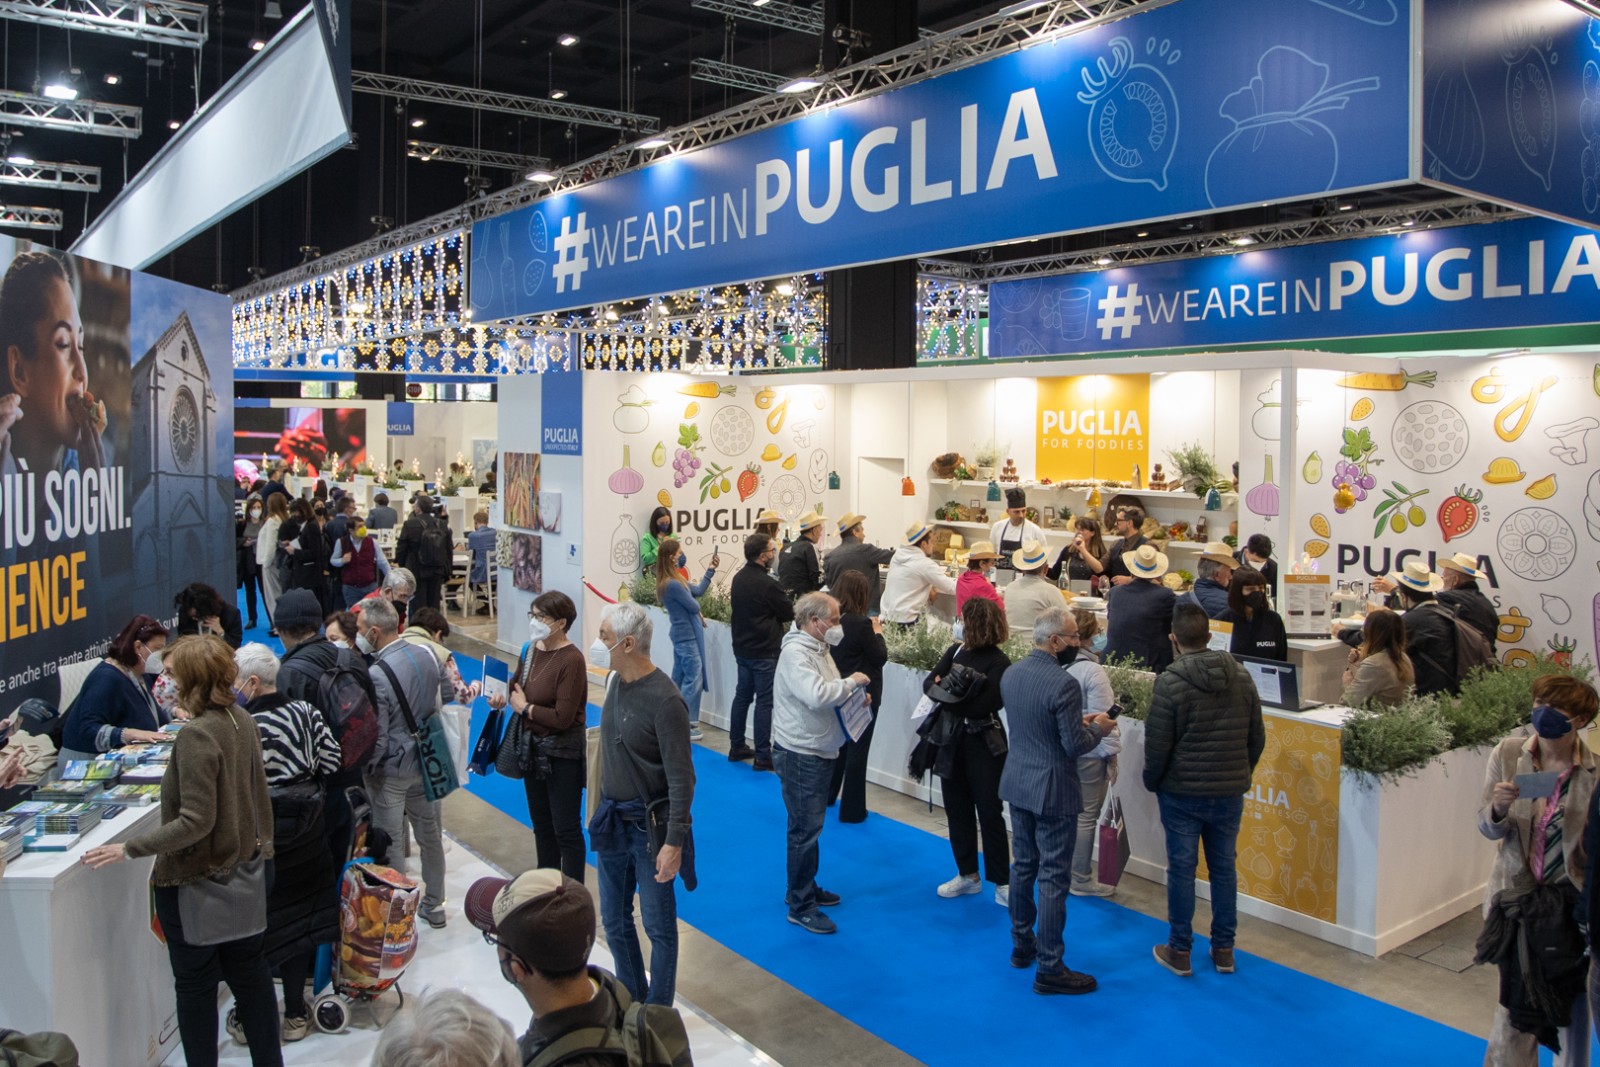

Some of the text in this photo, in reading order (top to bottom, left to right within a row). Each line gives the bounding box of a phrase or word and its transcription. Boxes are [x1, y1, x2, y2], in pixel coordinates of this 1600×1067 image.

[552, 87, 1058, 293] #WEAREINPUGLIA
[1096, 234, 1600, 340] #WEAREINPUGLIA
[544, 428, 579, 443] PUGLIA
[1043, 410, 1142, 435] PUGLIA
[1042, 438, 1144, 450] FOR FOODIES
[44, 466, 131, 542] SOGNI.
[680, 536, 703, 546] OR
[9, 665, 41, 690] anche
[43, 661, 57, 676] tra
[59, 648, 83, 667] tante
